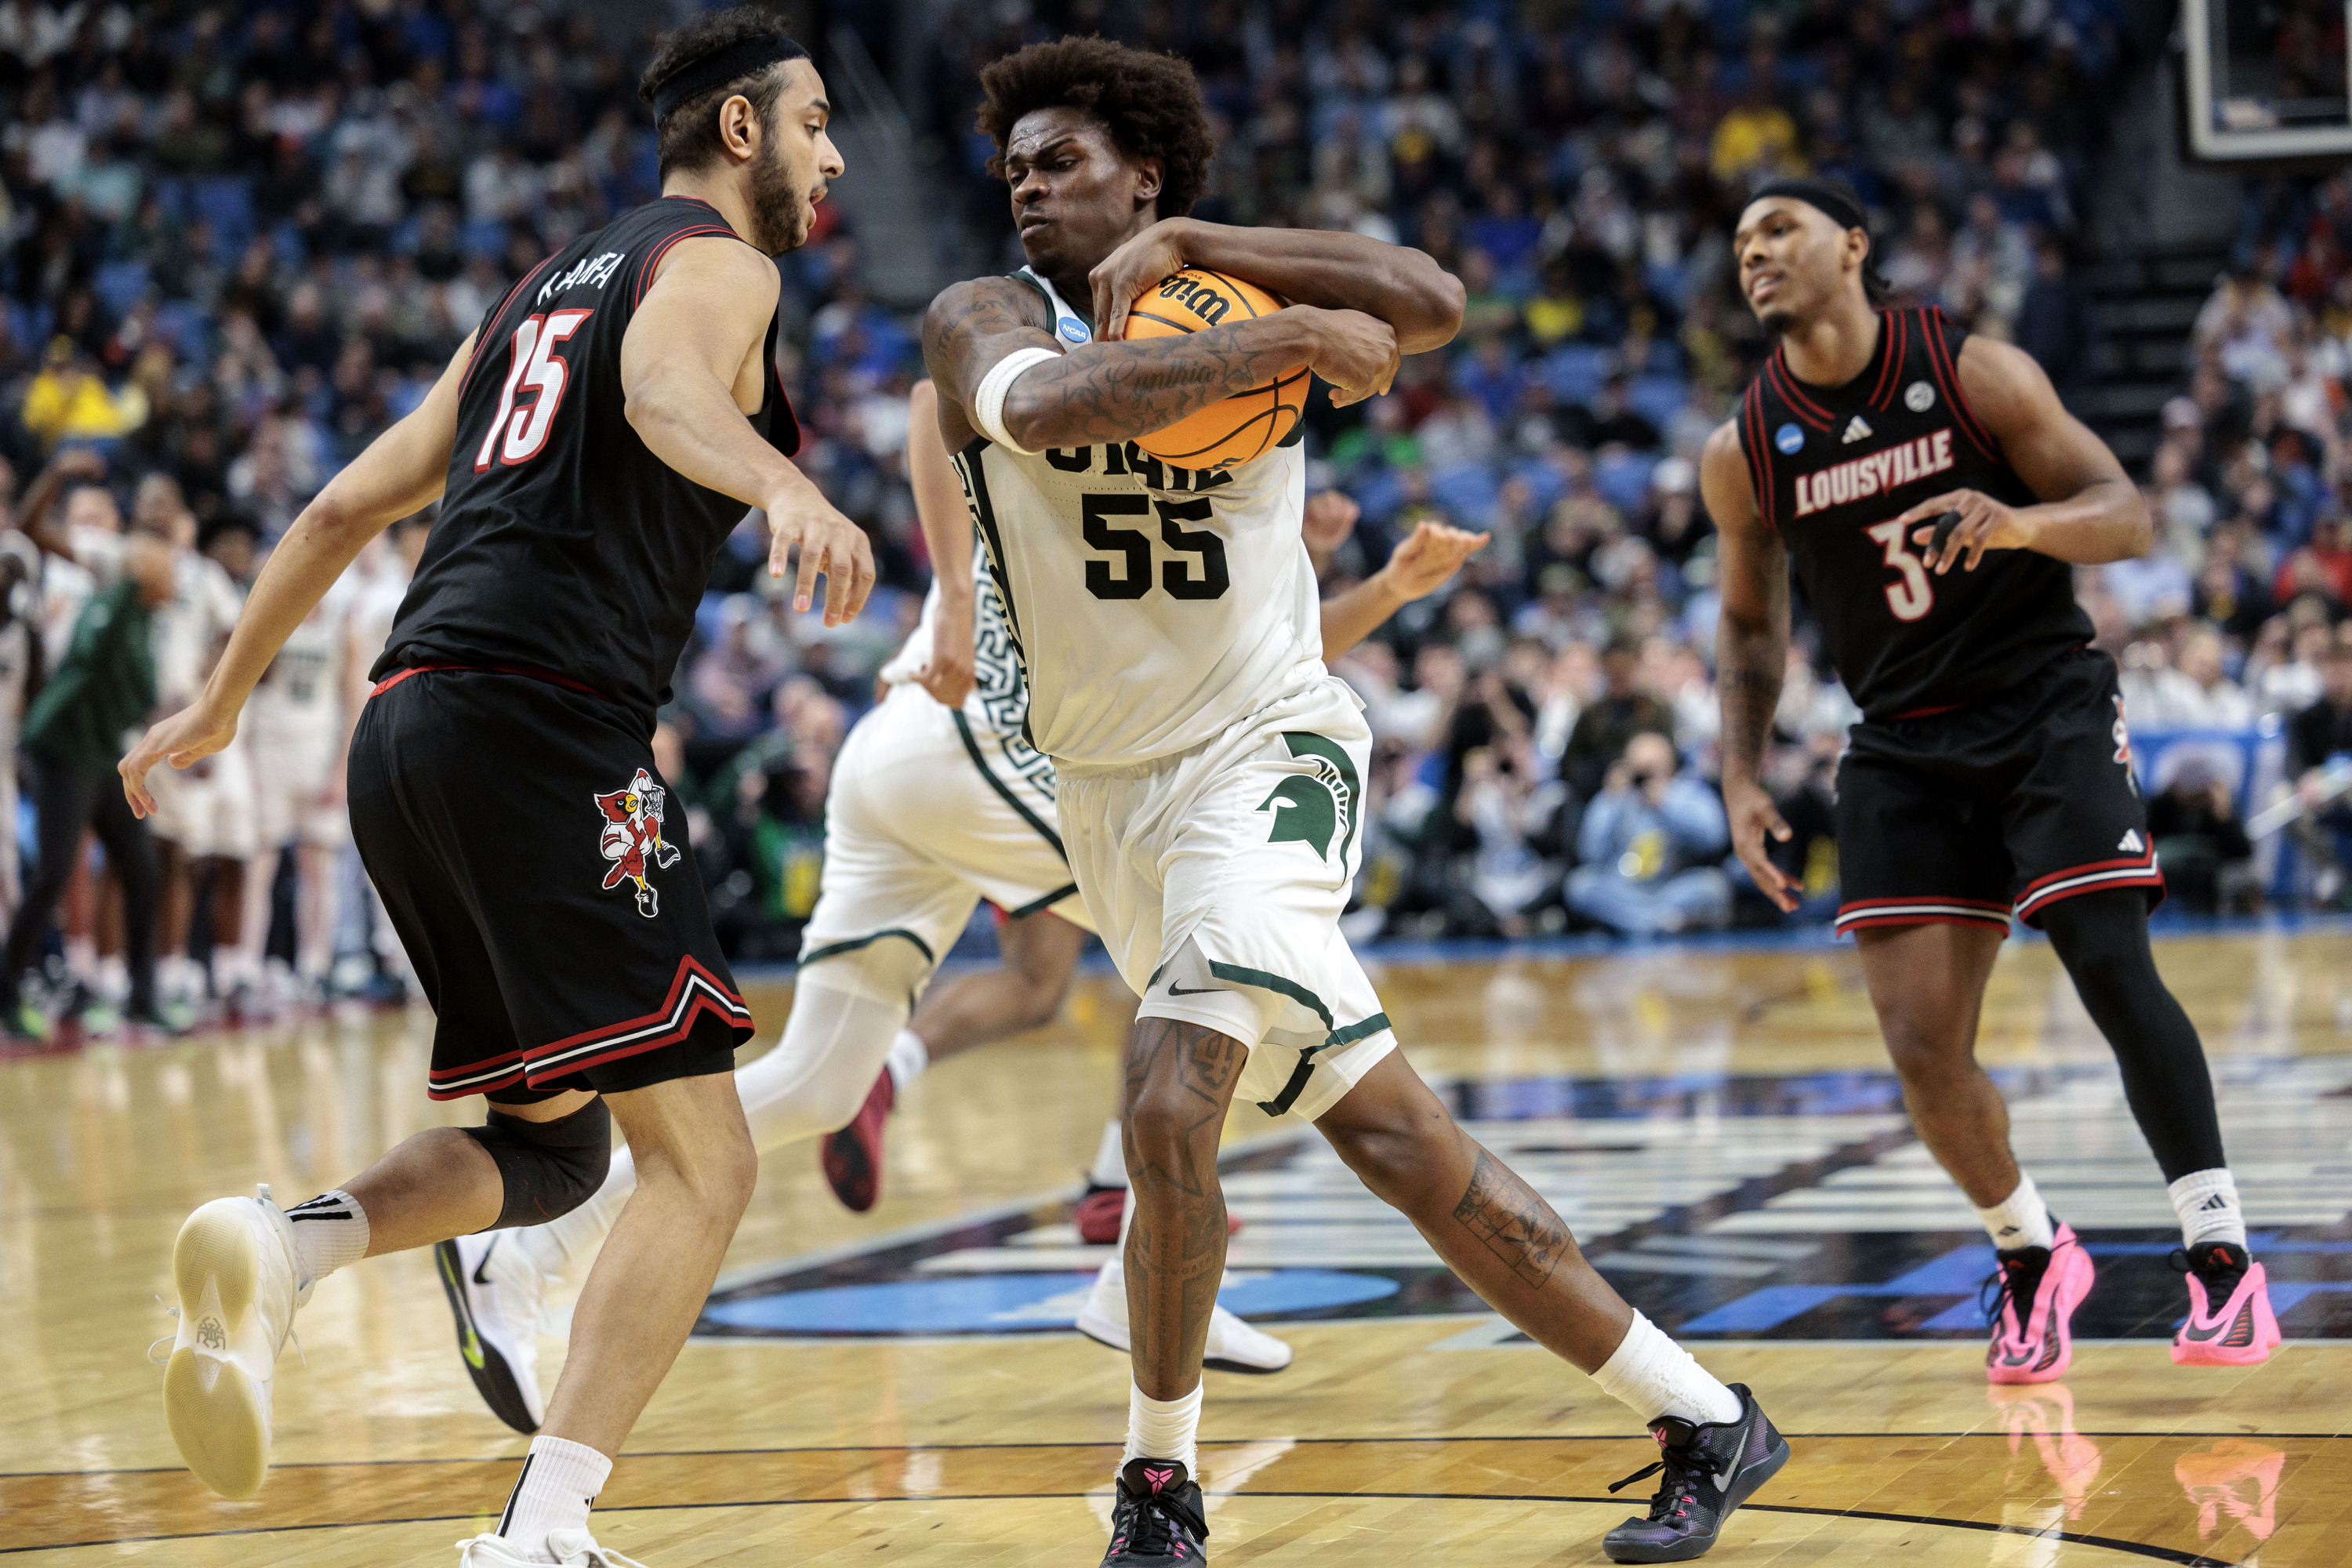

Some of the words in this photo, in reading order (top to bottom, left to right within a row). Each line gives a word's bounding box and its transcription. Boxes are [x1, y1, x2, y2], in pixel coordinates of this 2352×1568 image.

[1062, 323, 1087, 340] NCAA
[475, 309, 595, 474] 15
[1795, 427, 1955, 519] LOUISVILLE
[1082, 493, 1230, 600] 55
[1860, 516, 1935, 622] 3
